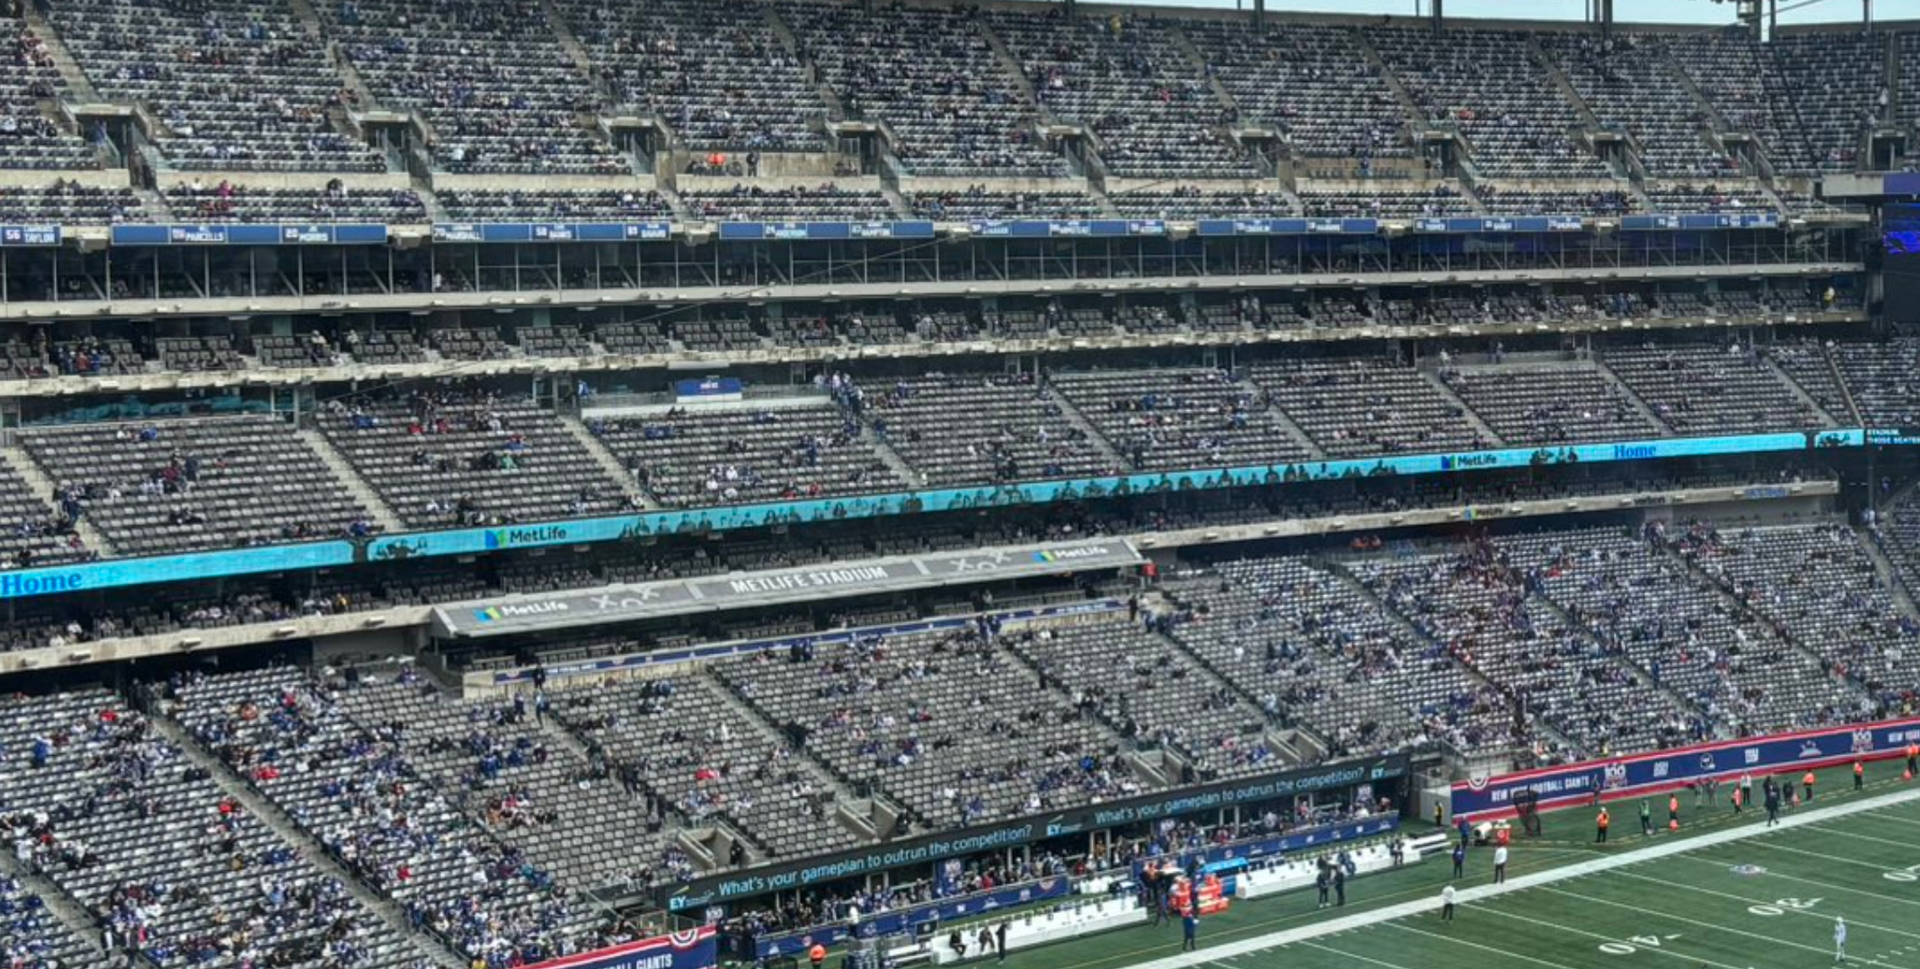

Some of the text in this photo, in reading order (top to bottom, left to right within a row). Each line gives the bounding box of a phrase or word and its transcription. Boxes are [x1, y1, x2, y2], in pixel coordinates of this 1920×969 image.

[1614, 444, 1656, 459] Home
[1457, 454, 1498, 466] MetLife
[510, 526, 567, 543] MetLife
[1, 573, 82, 595] Home
[731, 565, 888, 594] METLIFE STADIUM
[501, 601, 568, 616] MetLife
[1565, 775, 1590, 789] GIANTS
[1095, 767, 1364, 824] What's your gameplan to outrun the competition?
[718, 825, 1032, 897] What's your gameplan to outrun the competition?
[669, 896, 686, 910] EY
